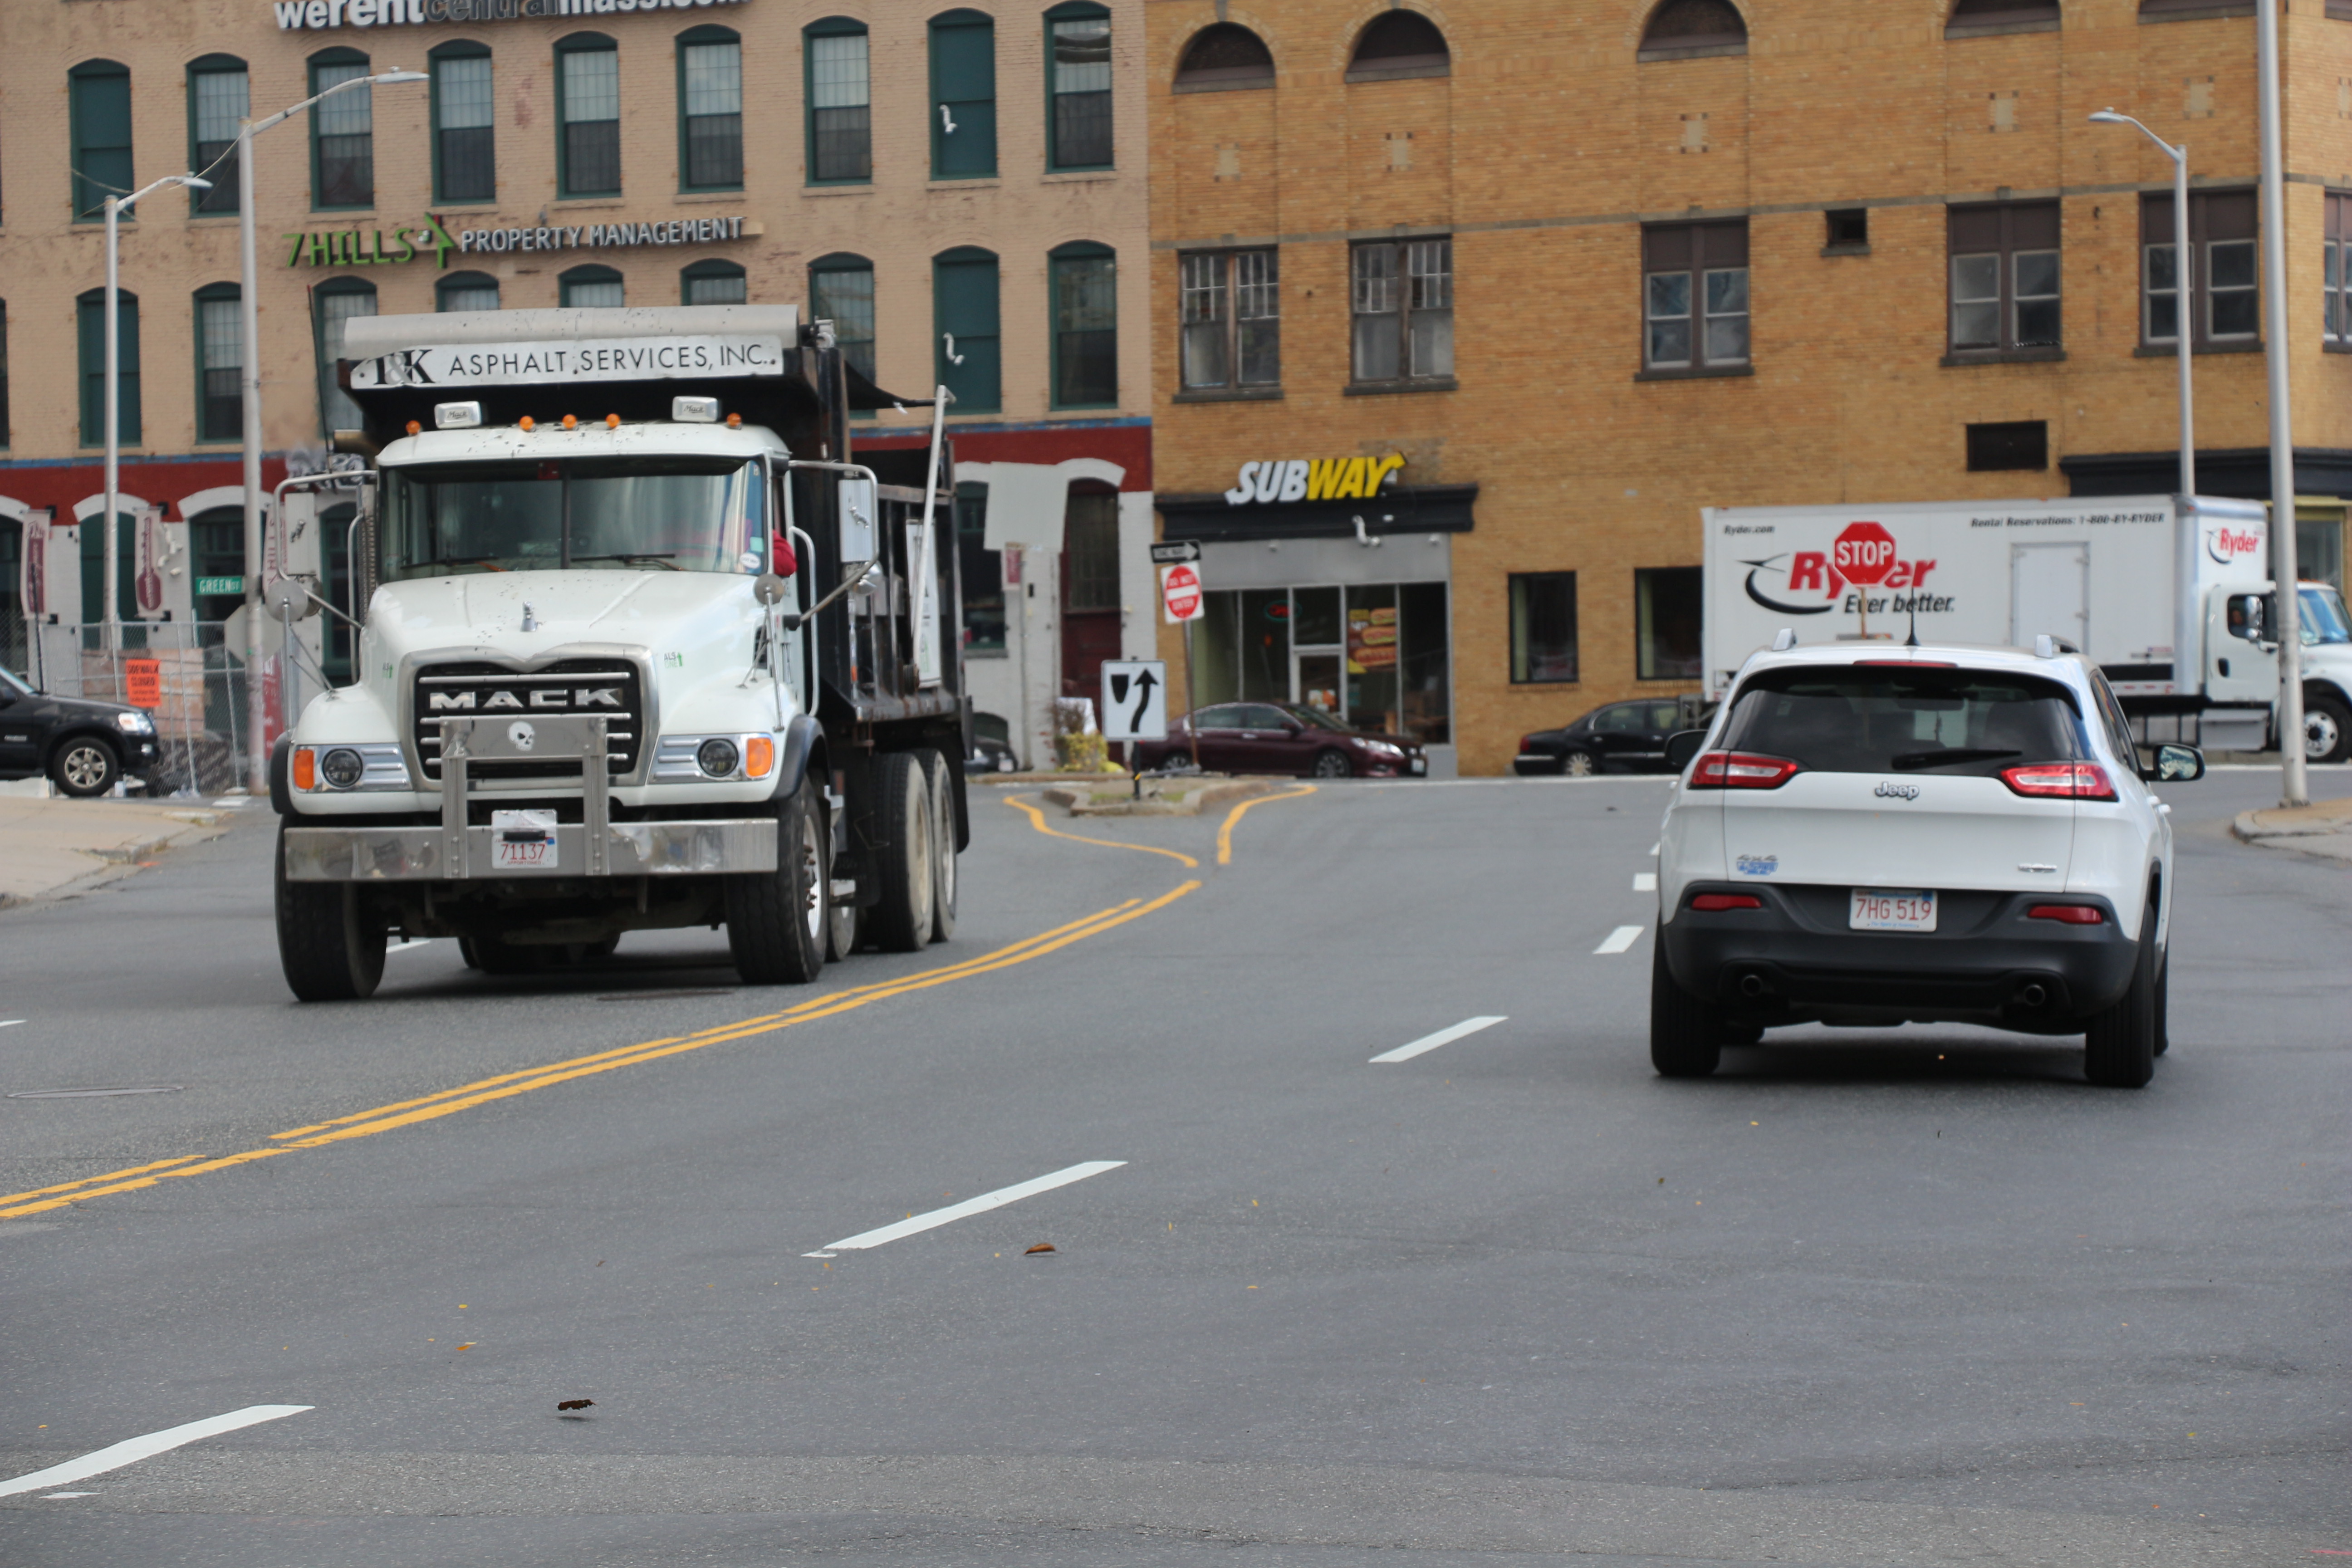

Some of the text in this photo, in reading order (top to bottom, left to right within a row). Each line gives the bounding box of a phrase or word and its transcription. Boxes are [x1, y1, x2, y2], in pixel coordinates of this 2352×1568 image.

[274, 0, 746, 29] werentcentrama.
[282, 217, 746, 267] 7HILLS PROPERTY MANAGEMENT
[448, 351, 567, 376] ASPHALT
[580, 345, 713, 371] SERVICES,
[1224, 451, 1406, 506] SUBWAY
[1724, 524, 1775, 534] Ryder.com
[1971, 517, 2003, 528] Rental
[1836, 540, 1893, 566] STOP
[2220, 527, 2259, 557] Ryder
[200, 578, 231, 593] GREEN
[1789, 551, 1937, 600] Ryer
[1893, 593, 1955, 612] better.
[429, 688, 622, 709] MACK
[1875, 781, 1920, 801] Jeep
[500, 843, 546, 860] 71137
[1856, 898, 1932, 921] 7HG 519
